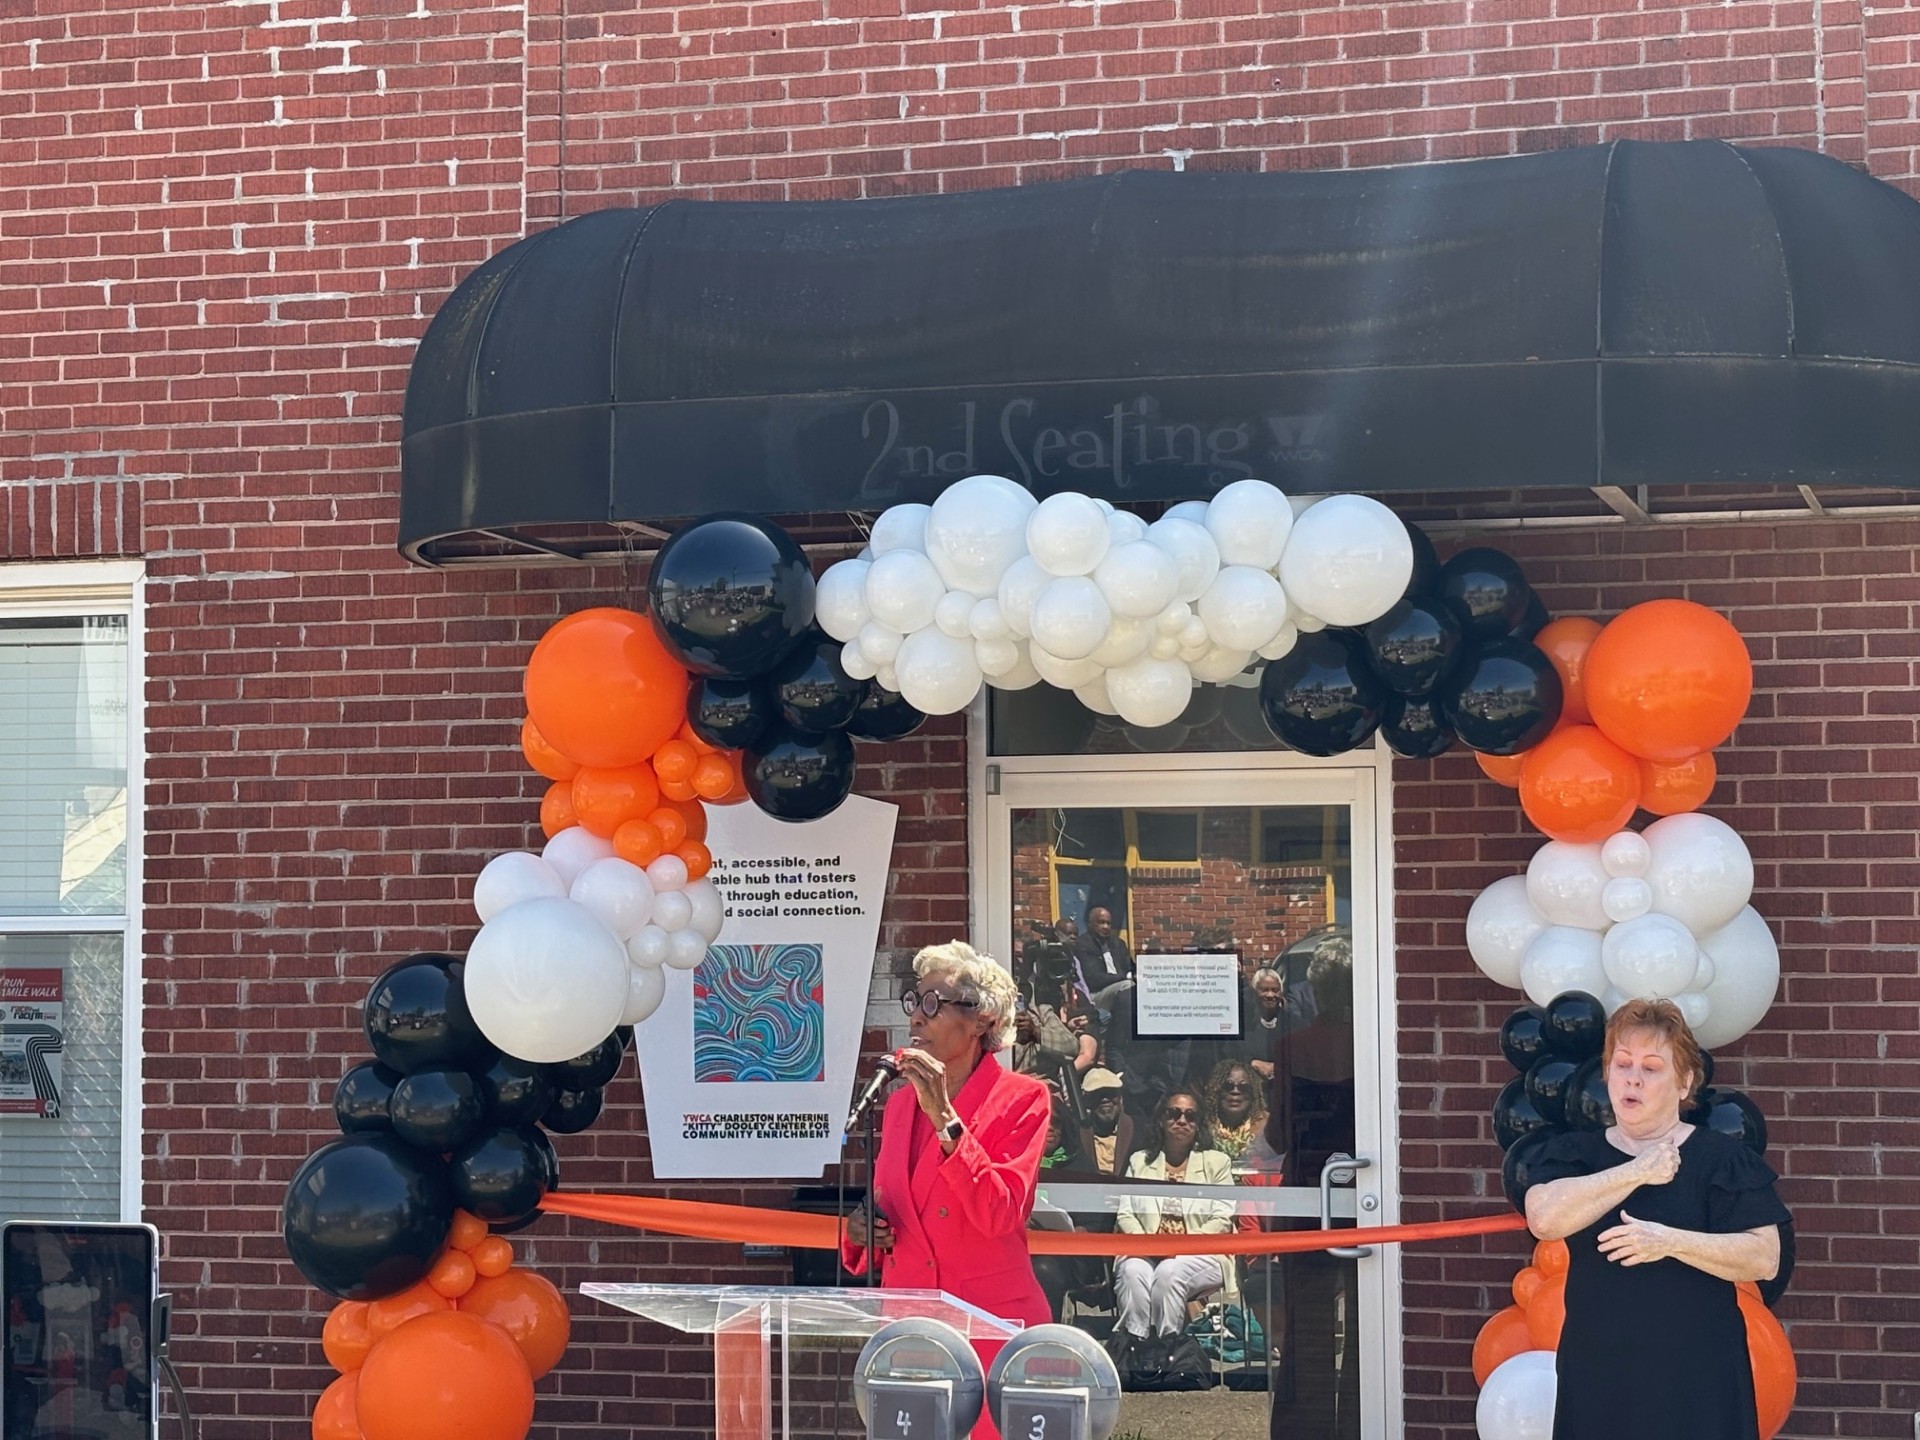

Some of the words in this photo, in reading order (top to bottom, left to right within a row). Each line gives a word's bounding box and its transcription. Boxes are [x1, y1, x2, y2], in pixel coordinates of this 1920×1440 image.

[861, 399, 977, 499] 2nd
[1000, 395, 1252, 489] Seating
[731, 856, 811, 869] accessible,
[815, 855, 841, 867] and
[712, 873, 741, 885] able
[745, 873, 771, 885] hub
[775, 872, 803, 884] that
[807, 872, 857, 883] fosters
[727, 889, 781, 903] through
[784, 888, 859, 901] education,
[737, 905, 779, 917] social
[783, 904, 866, 917] connection.
[3, 977, 25, 988] RUN
[31, 987, 58, 997] WALK
[682, 1114, 712, 1123] YWCA
[713, 1113, 774, 1122] CHARLESTON
[776, 1113, 830, 1122] KATHERINE
[724, 1122, 765, 1130] DOOLEY
[768, 1122, 807, 1130] CENTER
[809, 1122, 830, 1130] FOR
[682, 1130, 754, 1139] COMMUNITY
[756, 1130, 830, 1139] ENRICHMENT
[896, 1409, 912, 1436] 4
[1028, 1414, 1046, 1440] 3
